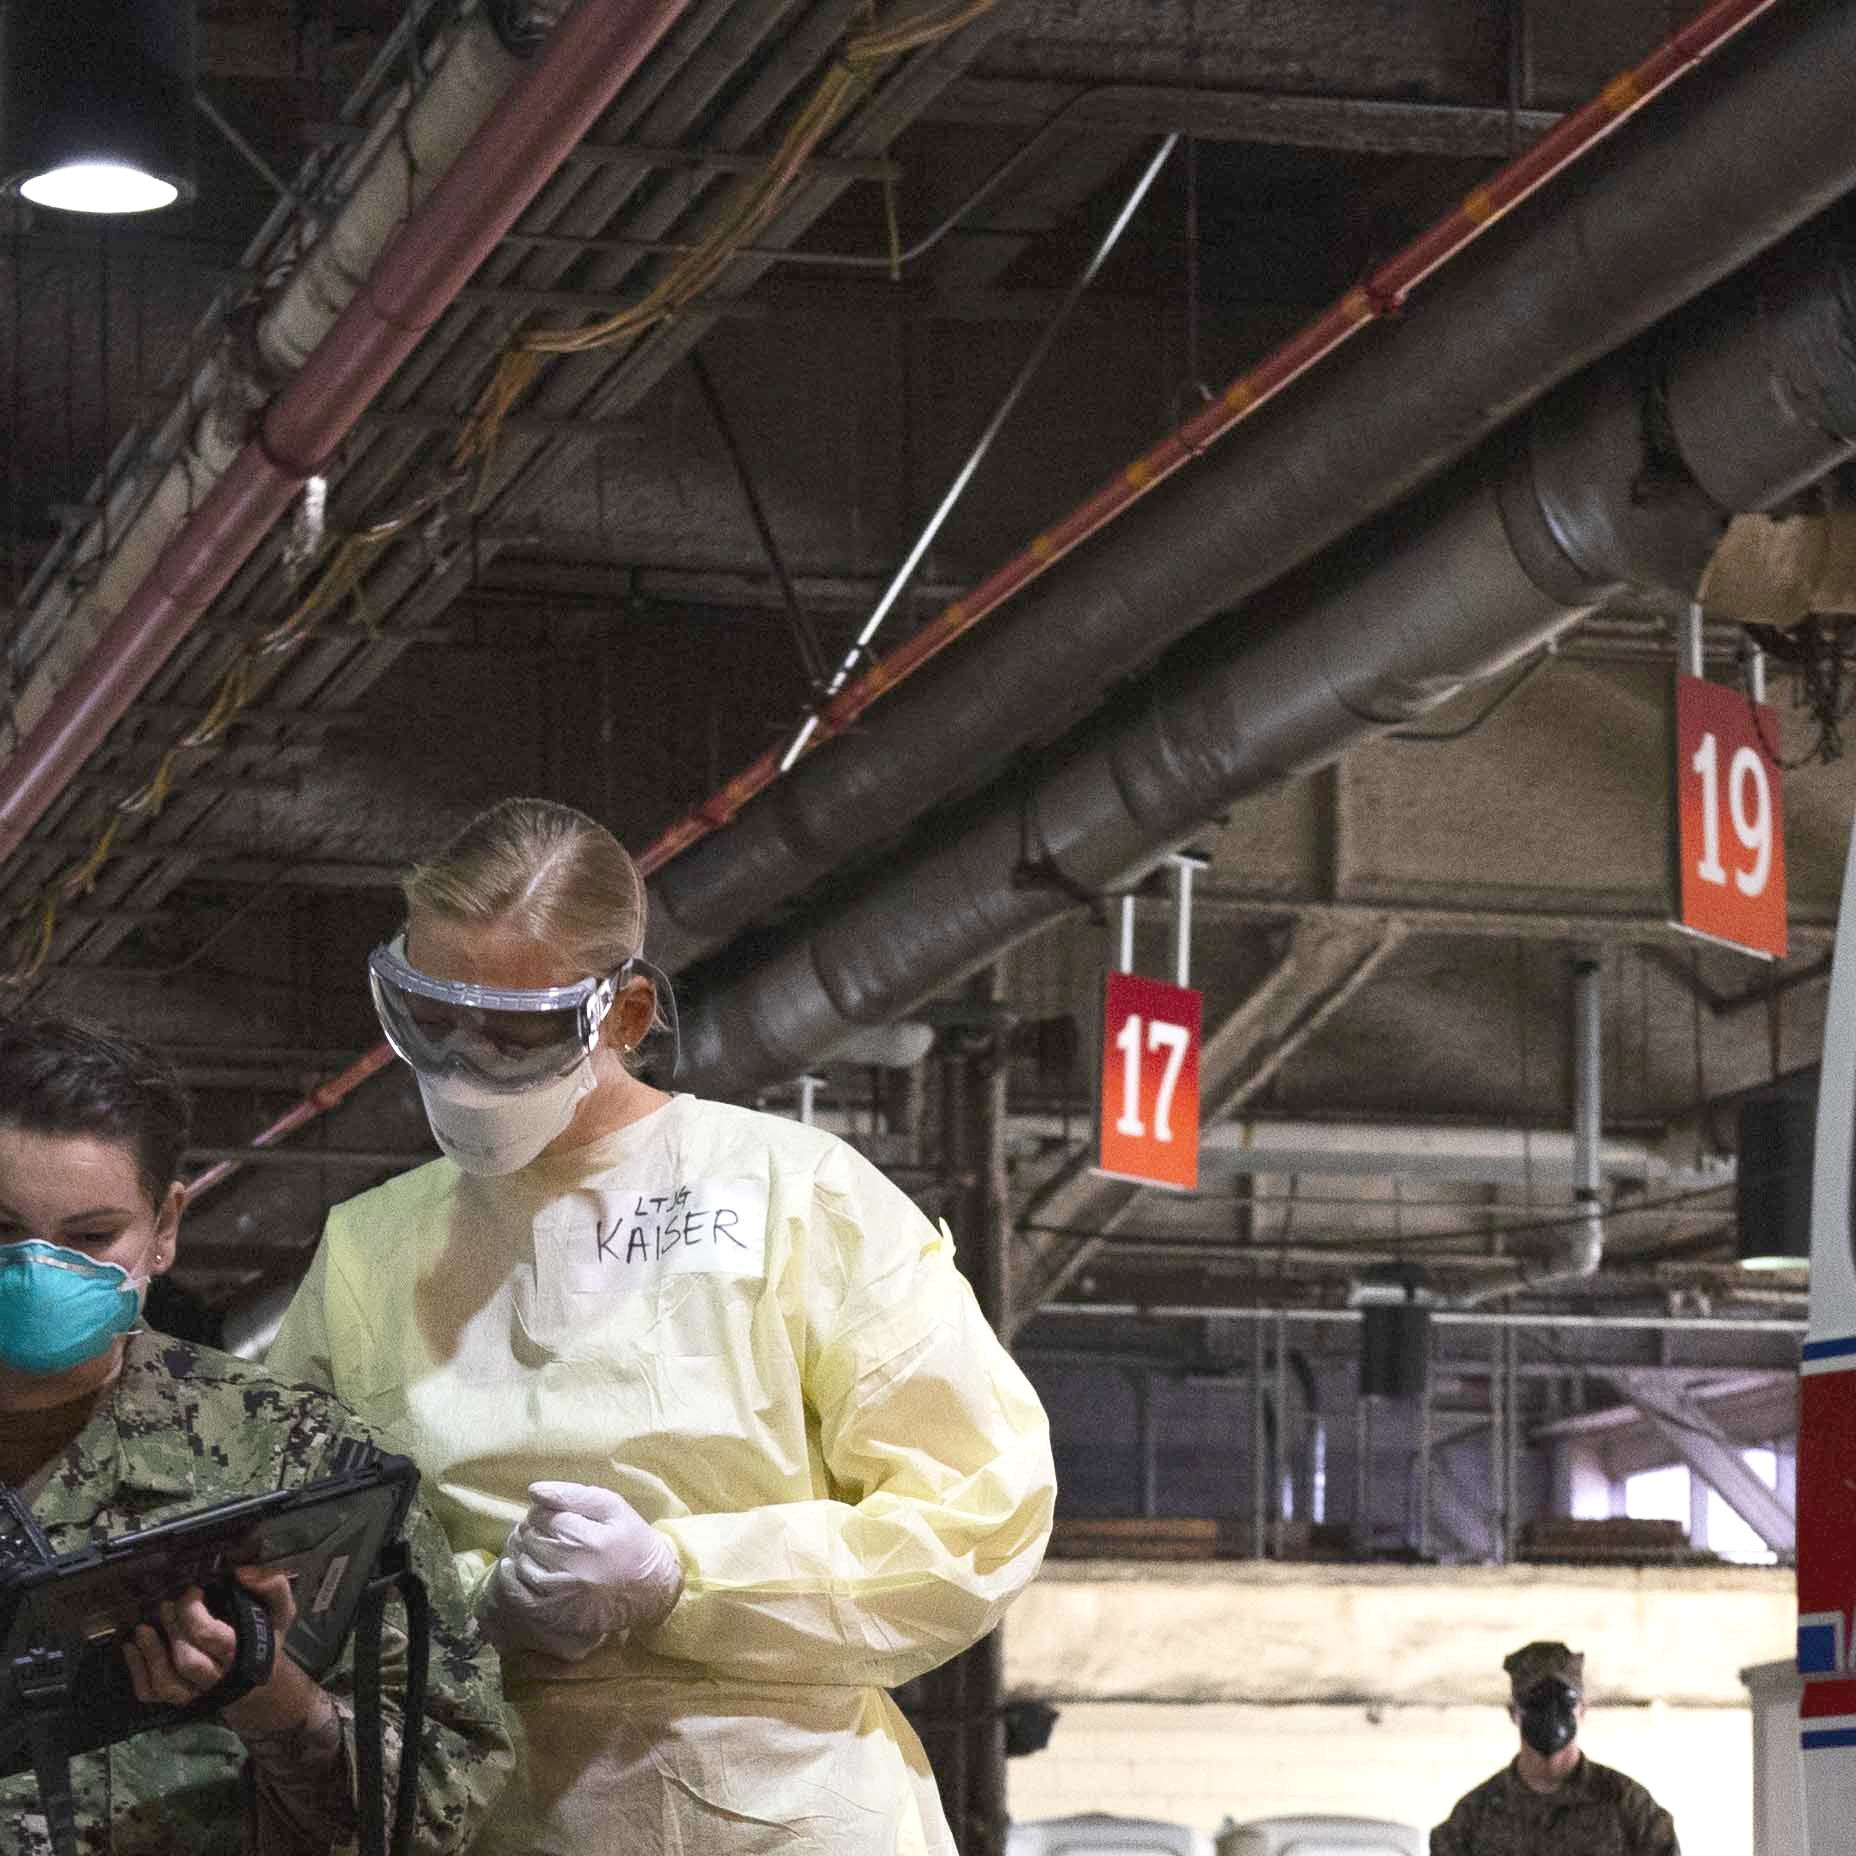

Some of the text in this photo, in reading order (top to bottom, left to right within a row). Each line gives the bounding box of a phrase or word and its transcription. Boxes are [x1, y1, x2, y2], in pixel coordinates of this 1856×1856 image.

[1692, 732, 1775, 898] 19
[1115, 1014, 1191, 1143] 17
[596, 1208, 747, 1265] KAISER
